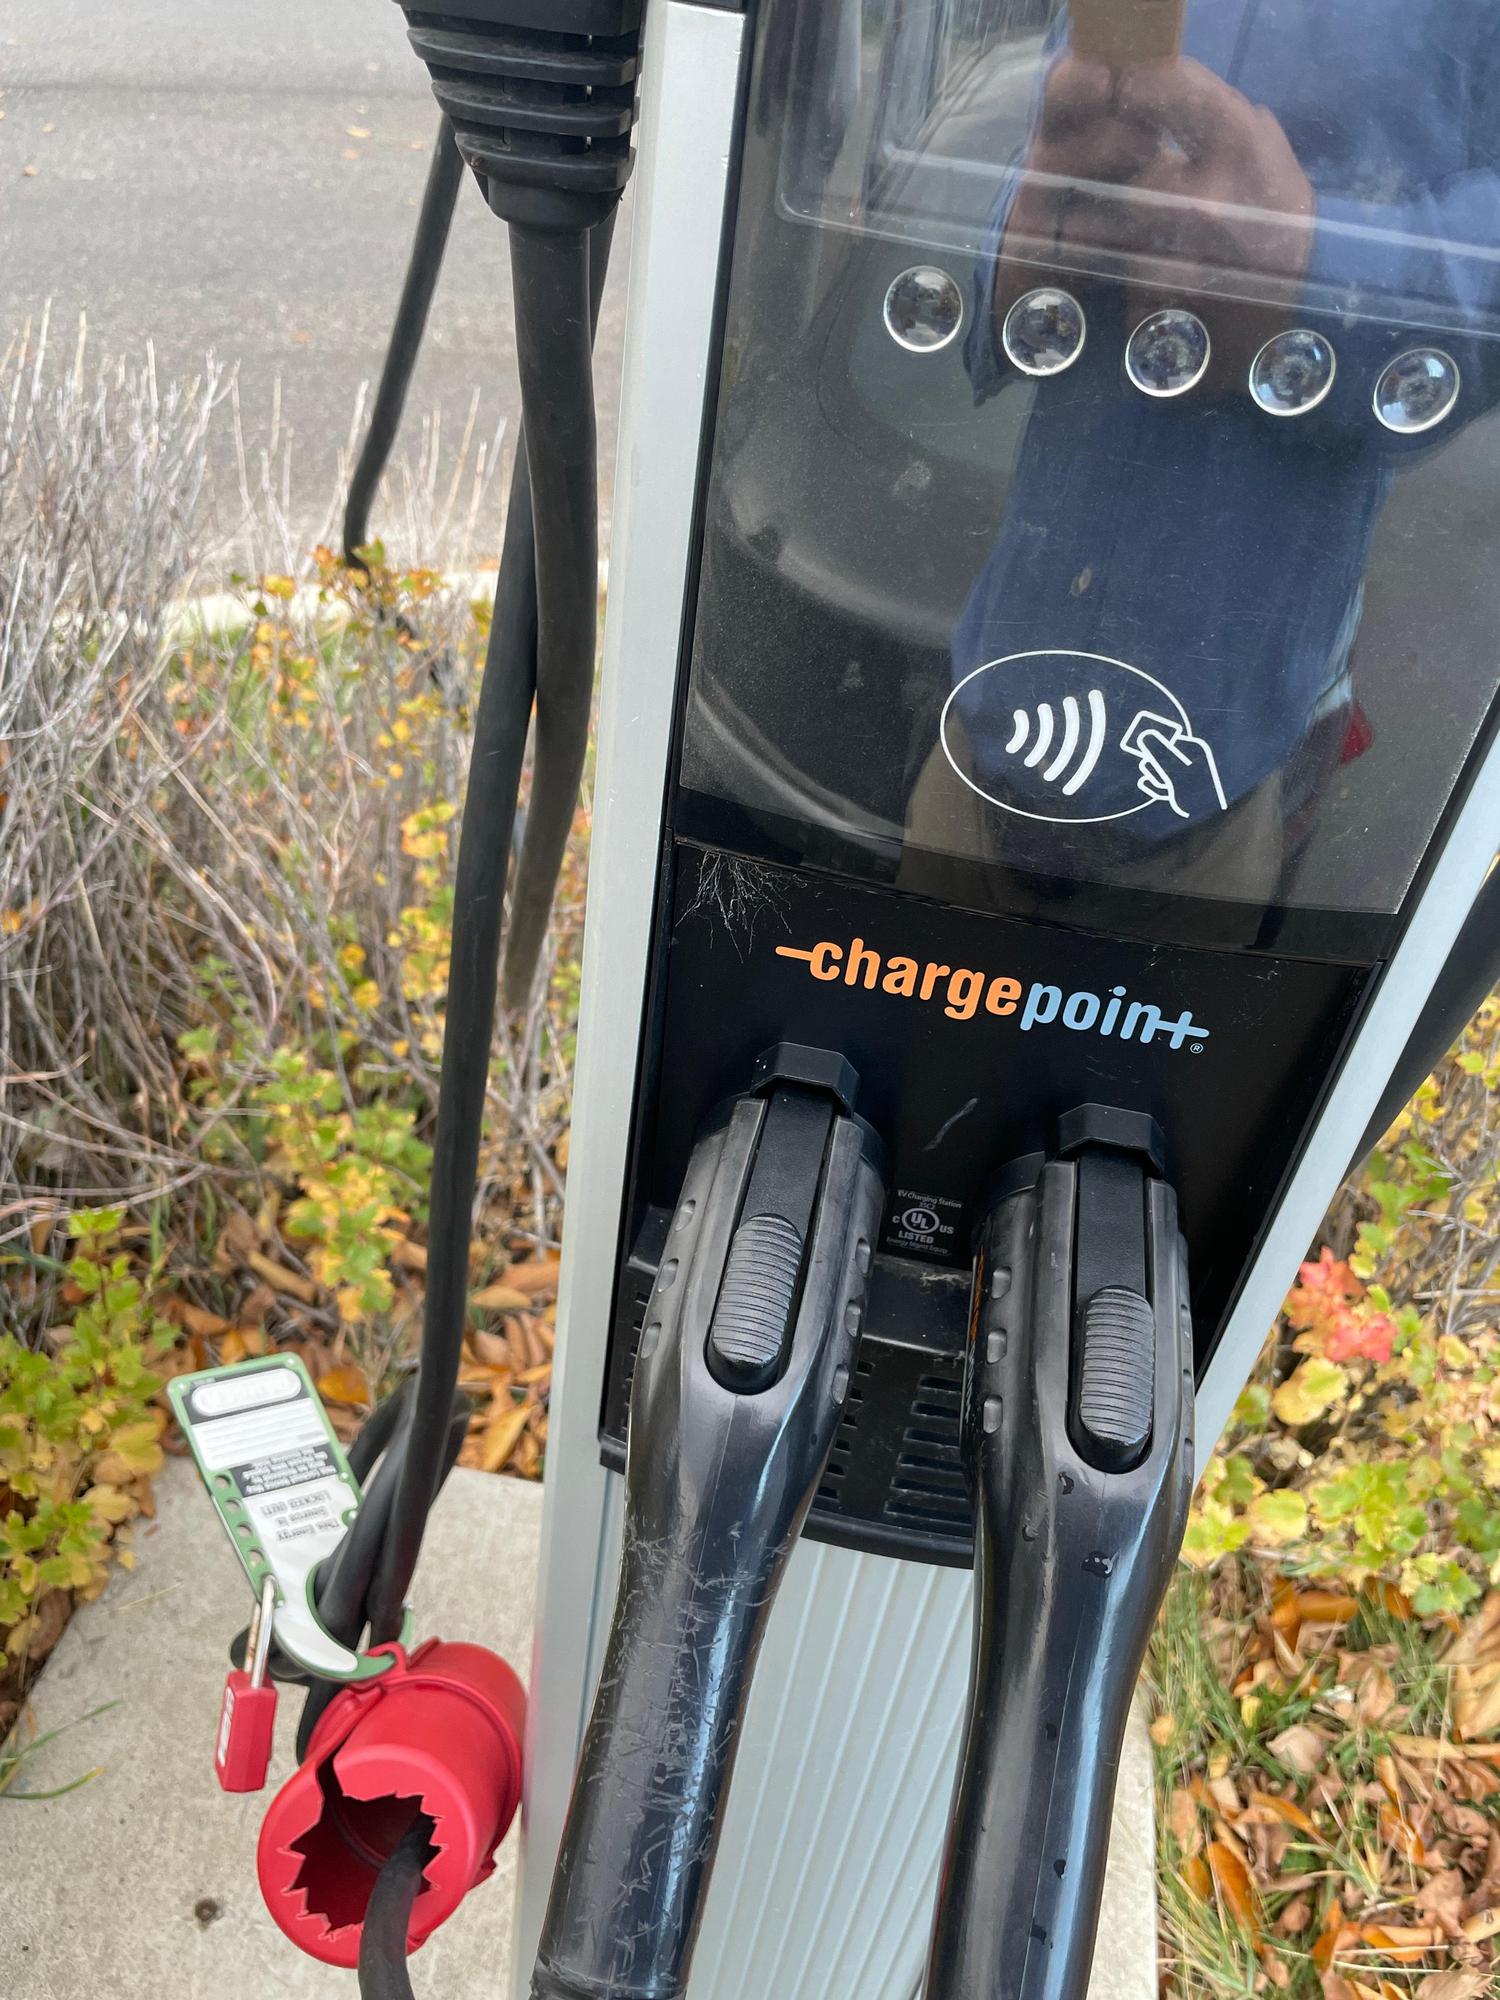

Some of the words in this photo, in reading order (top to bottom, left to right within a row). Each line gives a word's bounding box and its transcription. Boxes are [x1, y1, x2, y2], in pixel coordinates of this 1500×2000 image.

[907, 1191, 938, 1204] Charging
[938, 1196, 962, 1208] Station
[910, 1212, 929, 1229] UL
[940, 1224, 954, 1234] US
[898, 1230, 935, 1244] LISTED
